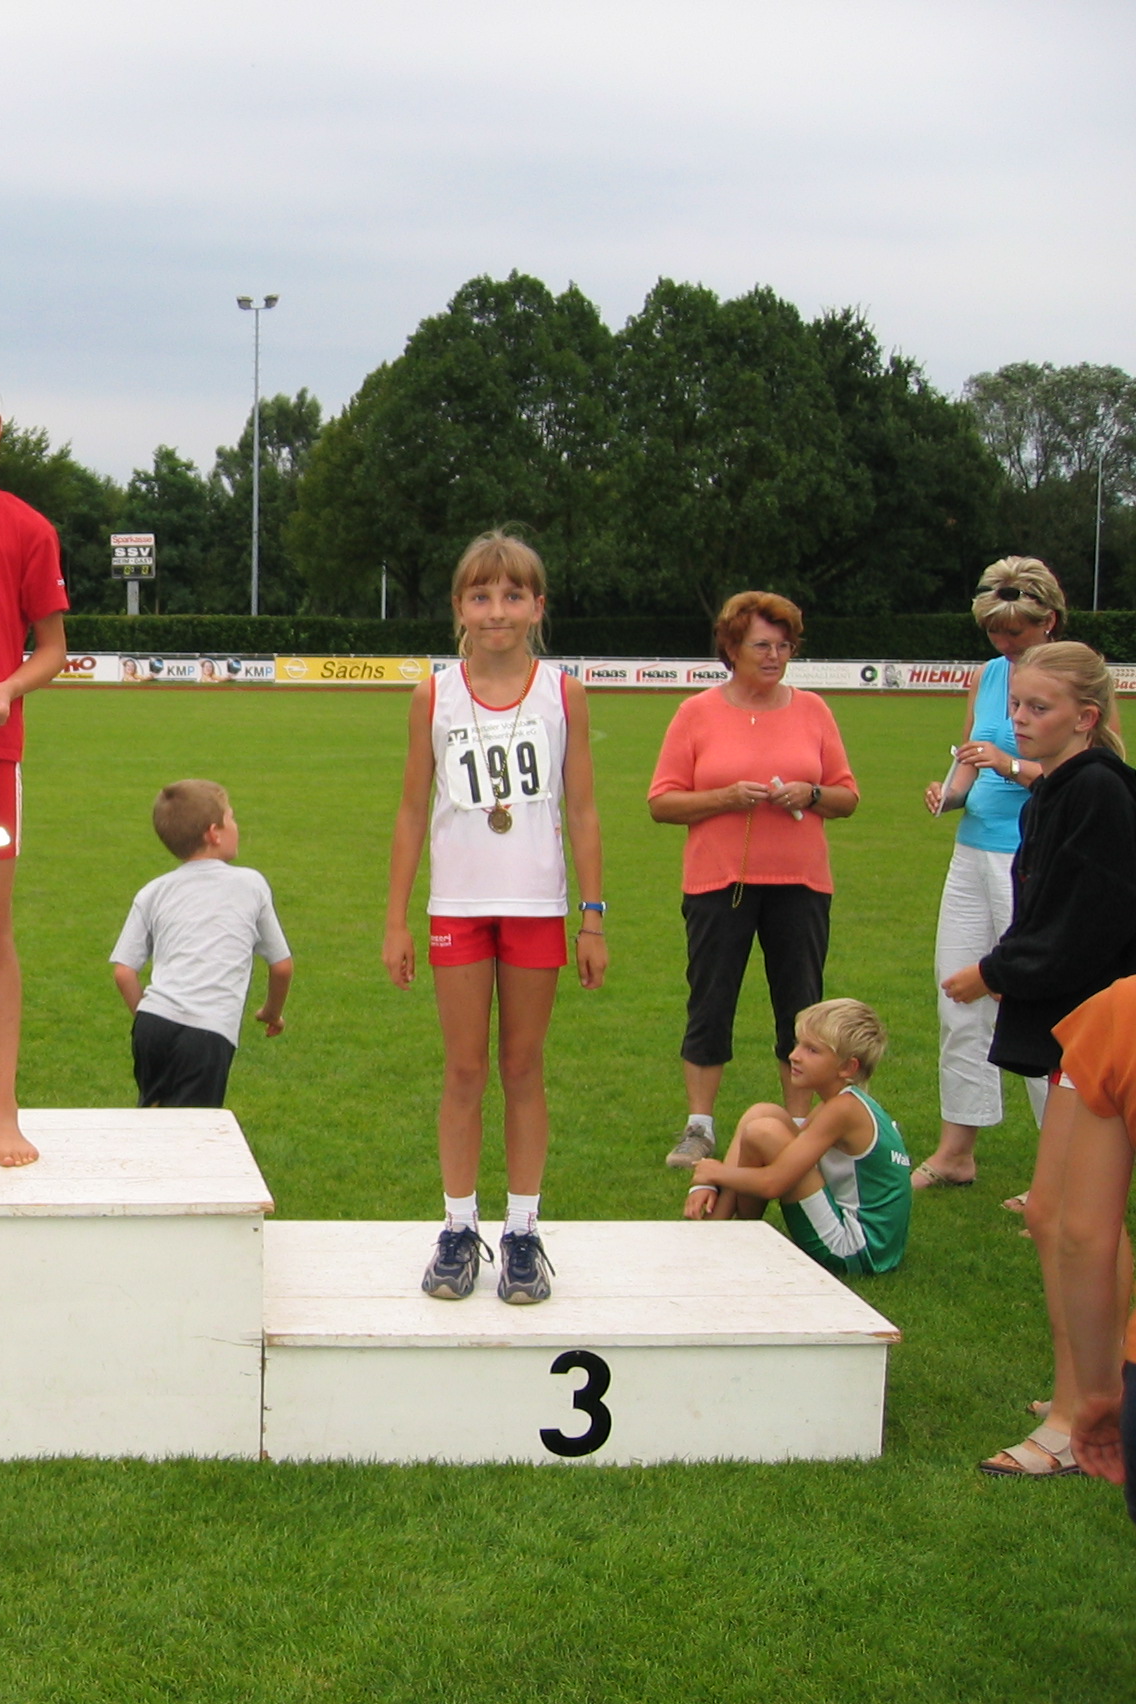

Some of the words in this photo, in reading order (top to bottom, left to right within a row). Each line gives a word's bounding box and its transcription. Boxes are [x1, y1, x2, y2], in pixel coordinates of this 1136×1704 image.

[114, 547, 151, 557] SSV
[167, 665, 195, 676] KMP
[245, 666, 273, 677] KMP
[320, 660, 386, 679] Sachs
[459, 741, 541, 803] 199
[539, 1349, 612, 1458] 3
